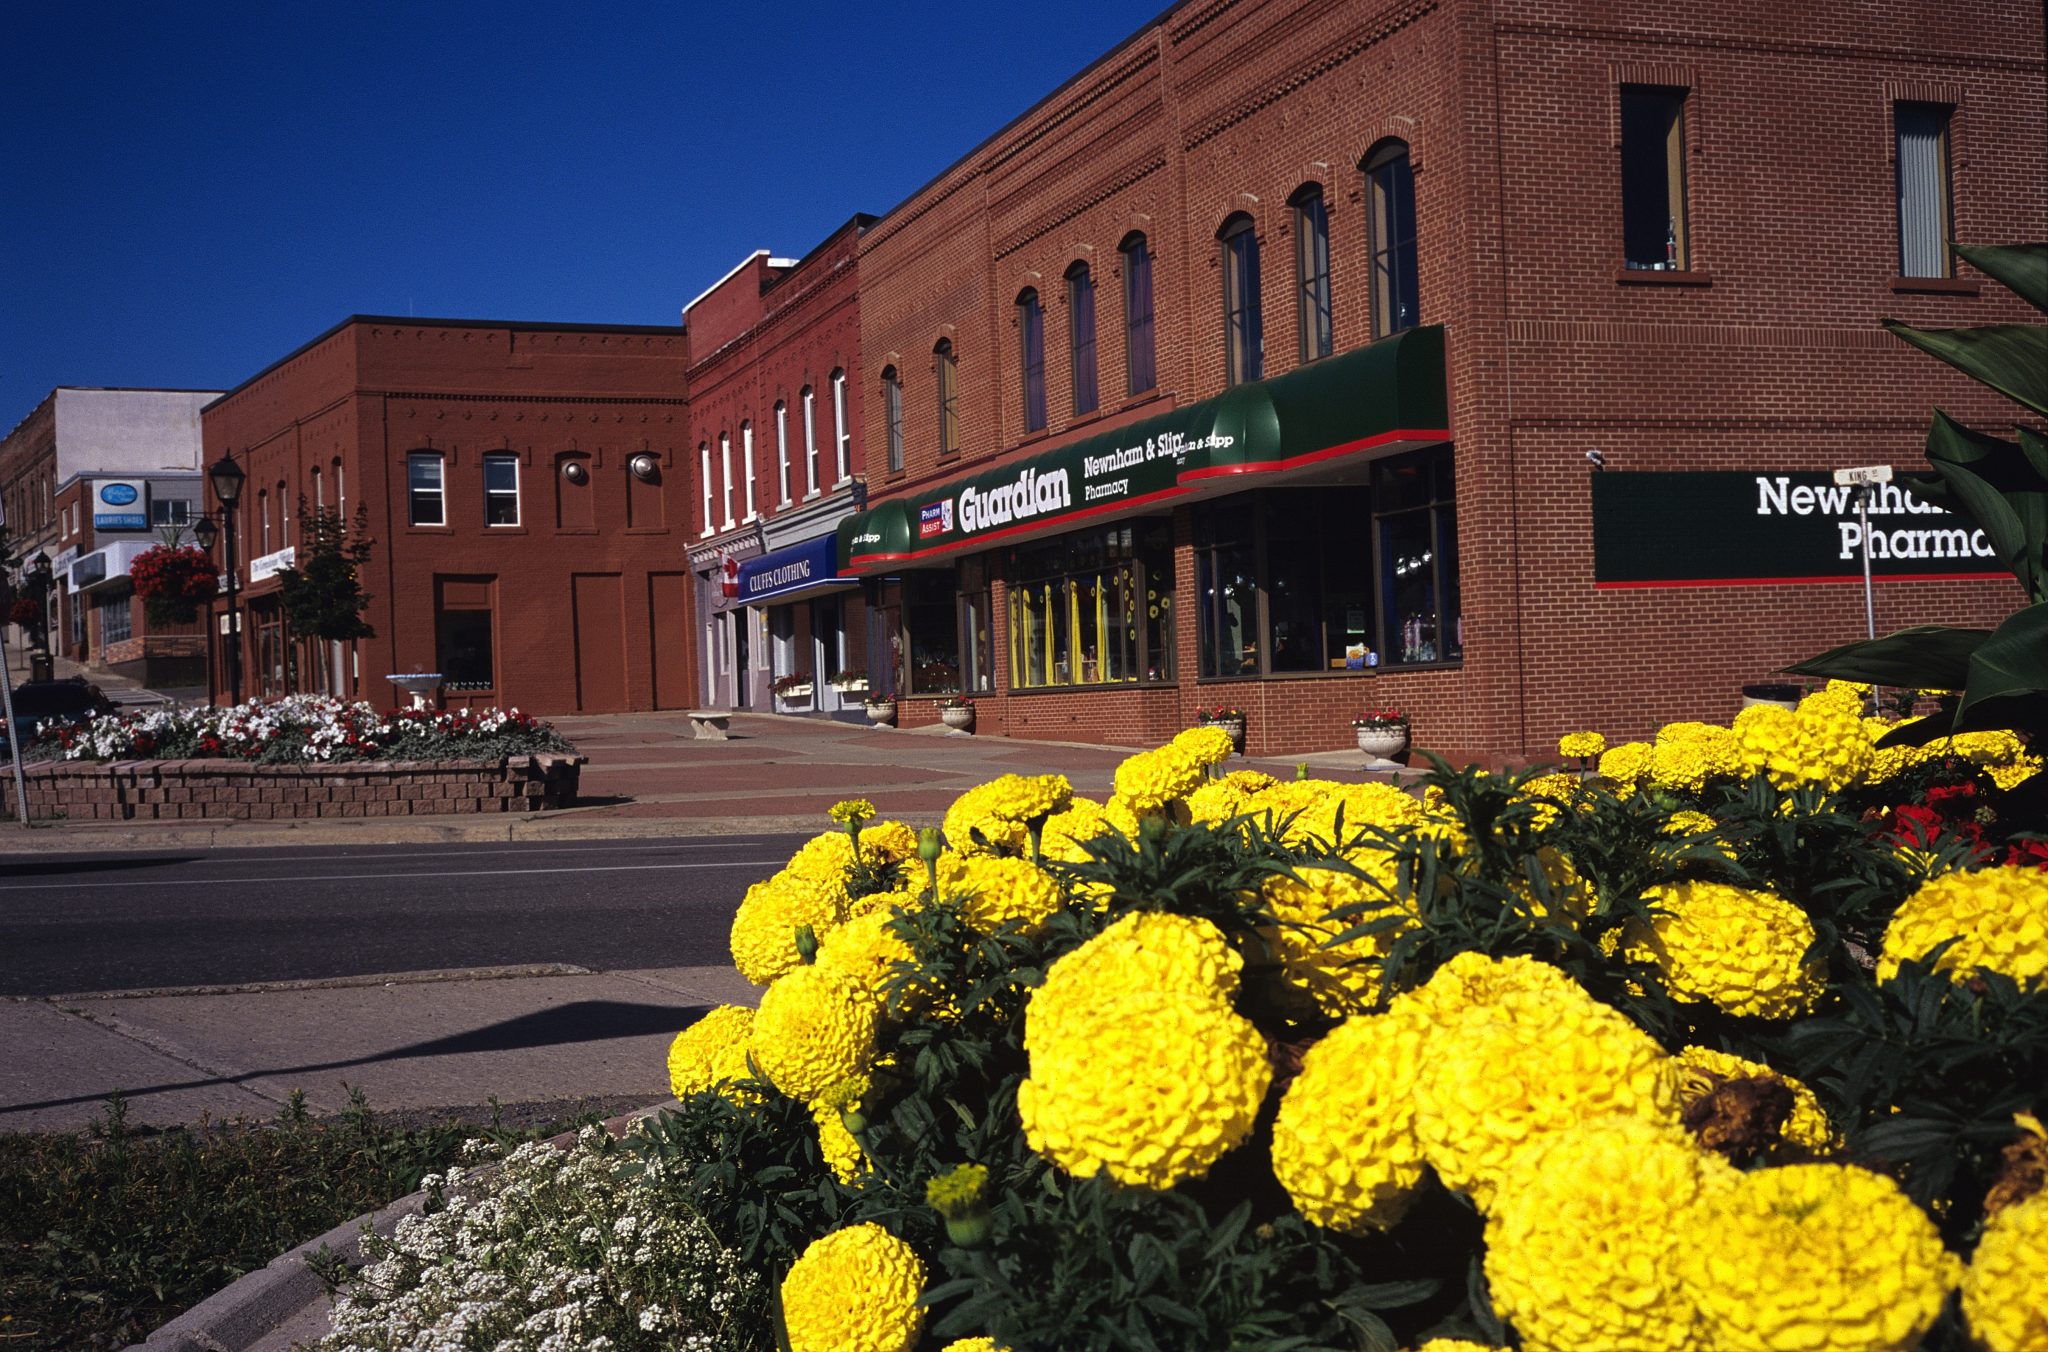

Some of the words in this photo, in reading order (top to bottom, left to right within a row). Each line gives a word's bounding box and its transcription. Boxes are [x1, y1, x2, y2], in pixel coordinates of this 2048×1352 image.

[1083, 447, 1144, 479] Newnham
[1146, 438, 1156, 461] &
[1157, 431, 1185, 459] Slip
[1849, 470, 1867, 482] KING
[958, 467, 1072, 534] Guardian
[1084, 478, 1129, 501] Pharmacy
[1756, 477, 1954, 515] Newha
[921, 507, 941, 521] PHARM
[922, 521, 941, 534] ASSIST
[773, 560, 810, 586] CLOTHING
